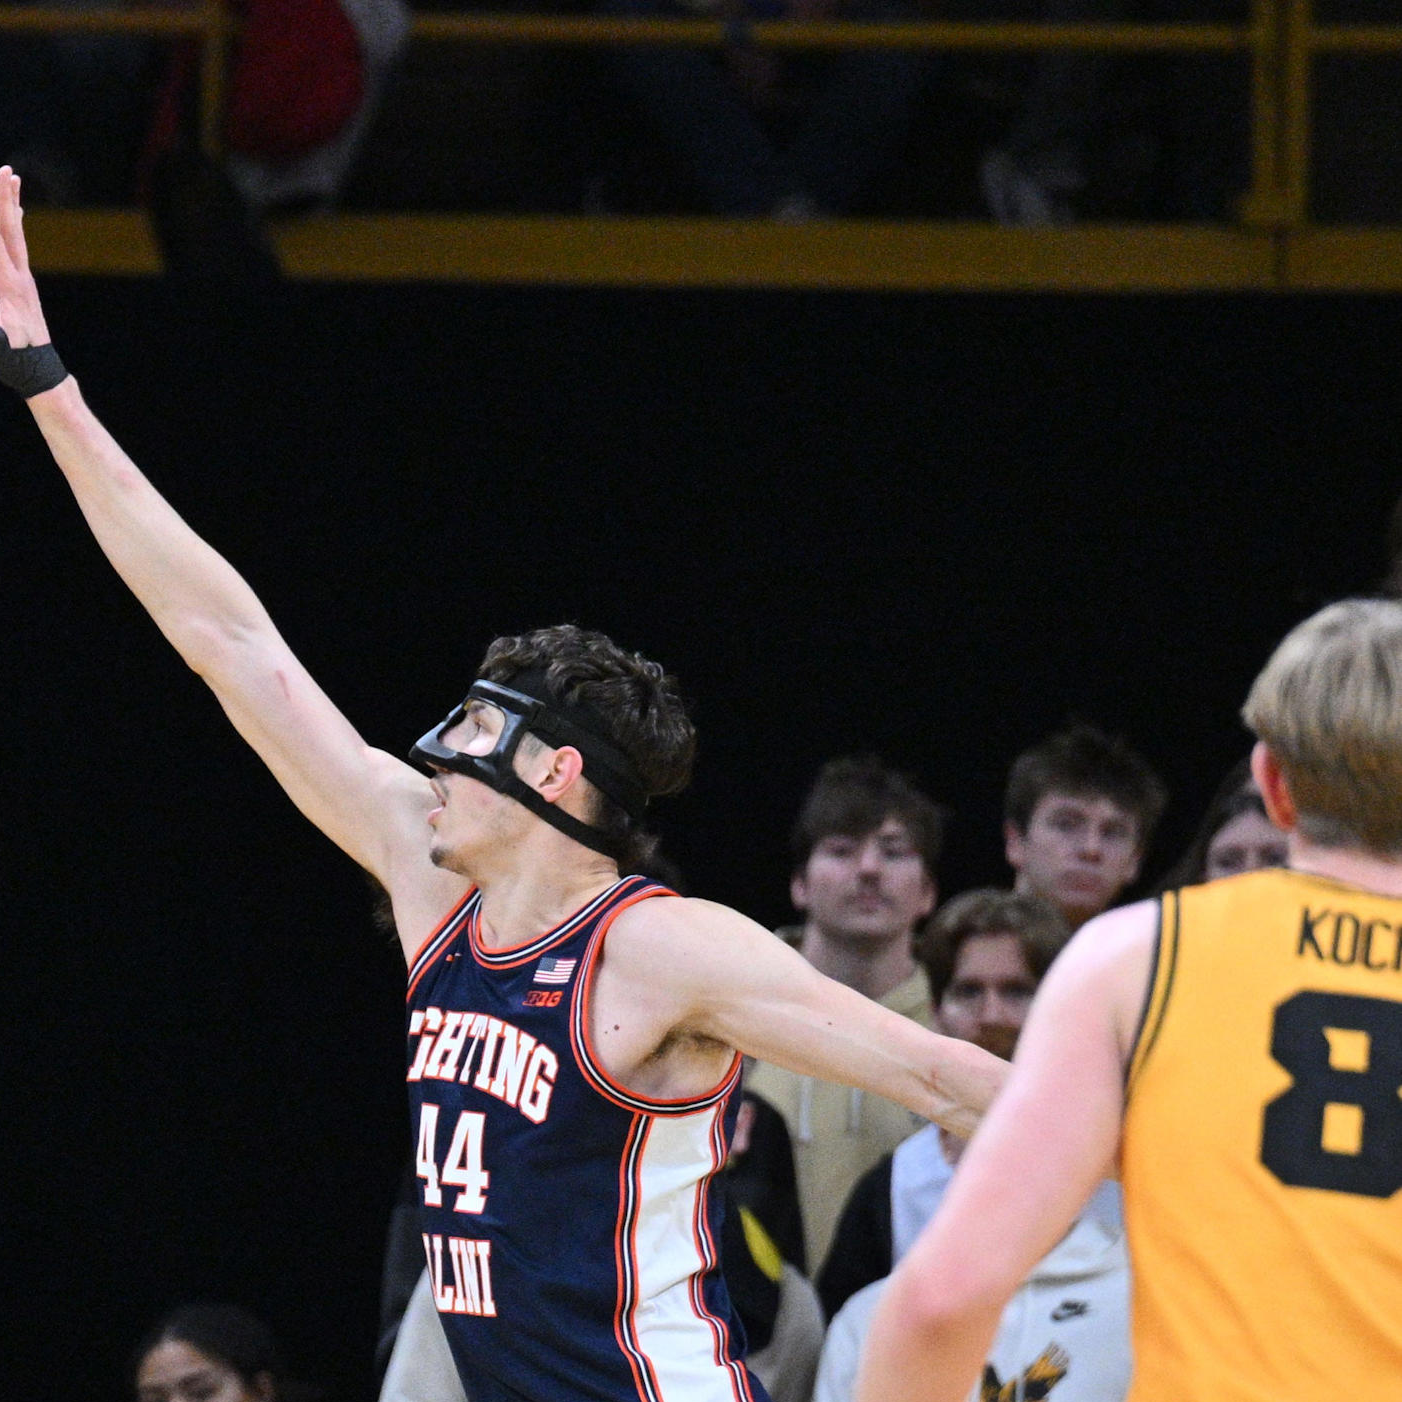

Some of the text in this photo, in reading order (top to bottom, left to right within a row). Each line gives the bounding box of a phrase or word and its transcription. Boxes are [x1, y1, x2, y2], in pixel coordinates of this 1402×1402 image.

[407, 1005, 559, 1125] GHTING
[416, 1102, 490, 1215] 44
[422, 1232, 497, 1317] LINI
